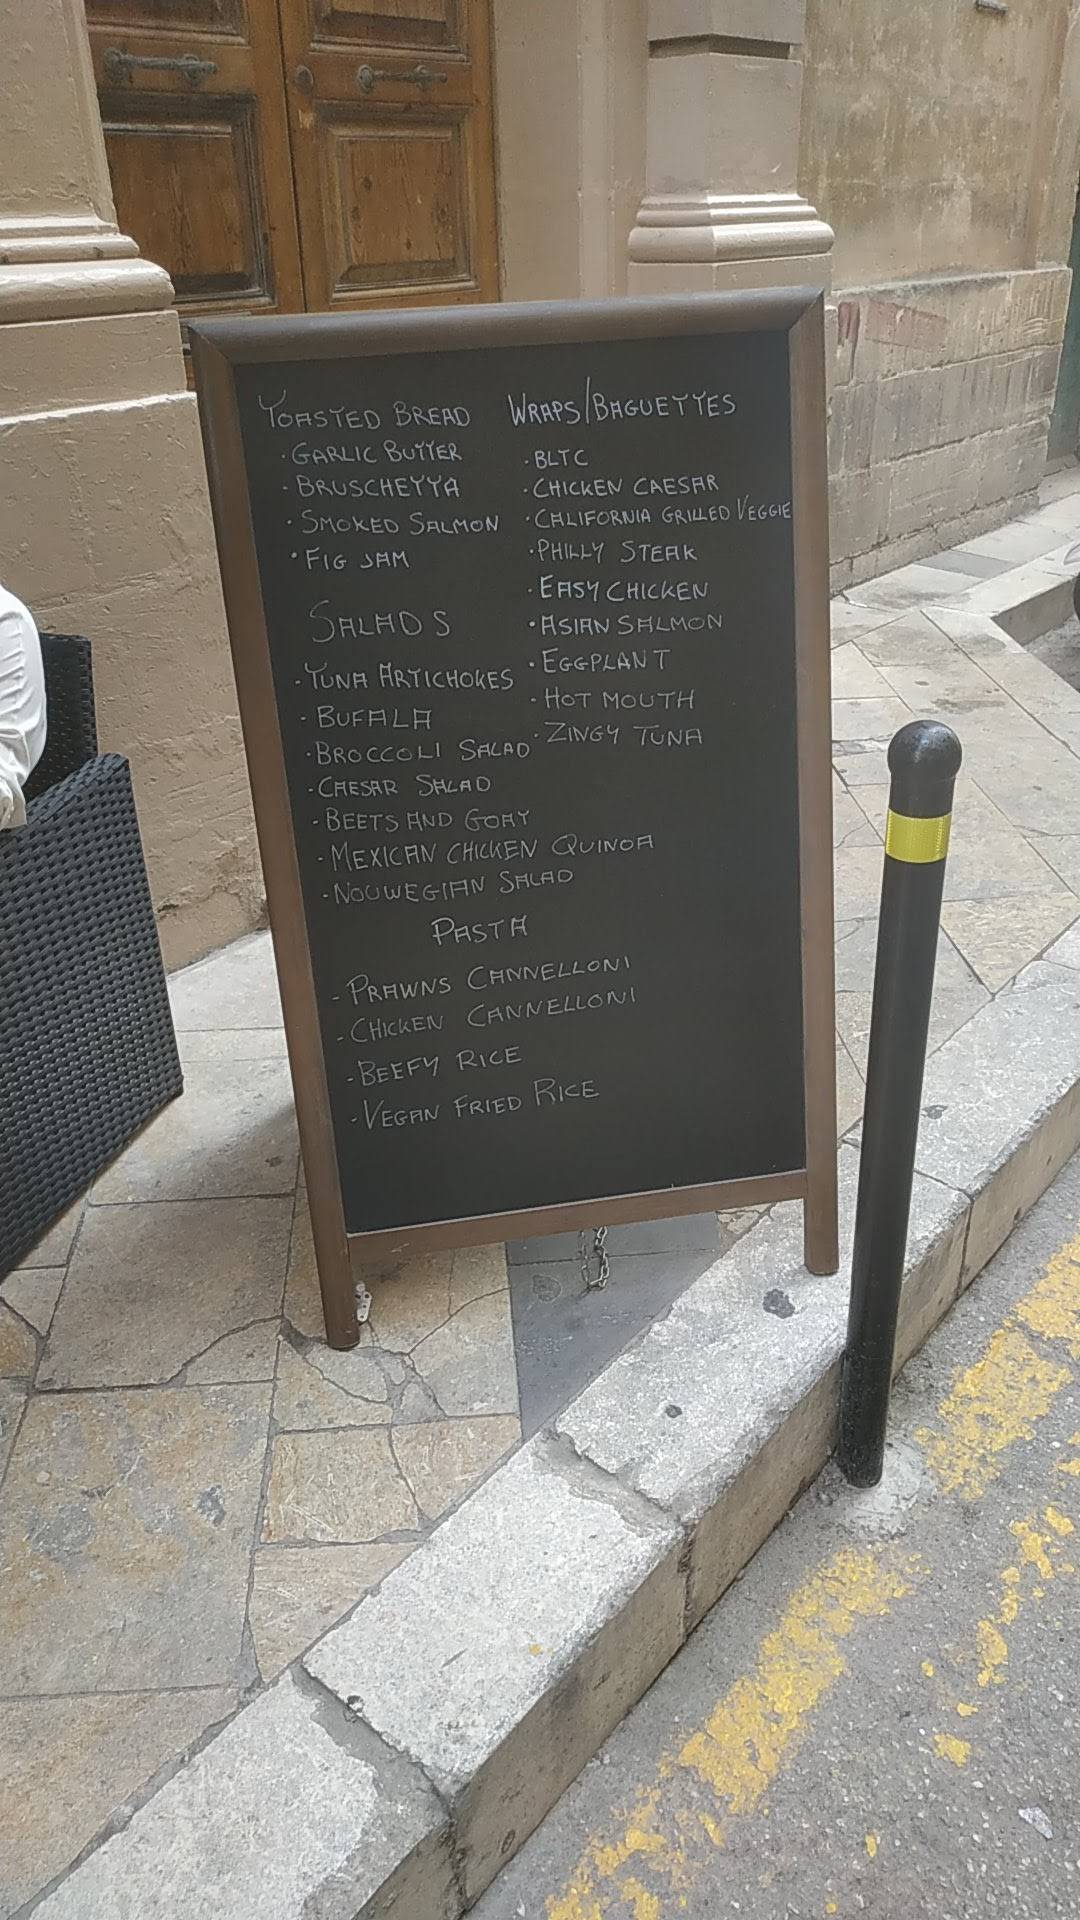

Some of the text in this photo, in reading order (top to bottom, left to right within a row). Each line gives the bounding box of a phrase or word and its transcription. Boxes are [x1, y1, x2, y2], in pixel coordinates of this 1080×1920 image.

[393, 400, 471, 427] BREAD
[291, 439, 463, 465] GARLIC BUTTER
[534, 449, 588, 469] BLTC
[296, 474, 460, 498] BRUSCHETTA
[532, 474, 719, 498] CHICKEN CAESAR
[301, 508, 500, 536] SMOKED SALMON
[534, 495, 792, 529] CALIFORNIA GRILLED VEGGIE
[306, 547, 411, 570] FIG JAM
[537, 539, 698, 563] PHILLY STEAK
[540, 575, 709, 602] EASY CHICKEN
[309, 600, 451, 643] SALADS
[541, 614, 723, 636] ASIAN SALMON
[542, 648, 671, 673] EGGPLANT
[304, 662, 514, 690] TUNA ARTICHOKES
[545, 687, 694, 709] HOT MOUTH
[317, 705, 432, 730] BUFALA
[545, 722, 703, 746] ZINGY TUNA
[315, 739, 530, 765] BROCCOLI SALAD
[317, 774, 491, 798] CAESAR SALAD
[326, 807, 399, 833] BEETS
[407, 811, 452, 831] AND
[331, 834, 654, 872] MEXICAN CHICKEN QUINOA
[500, 868, 574, 894] SALAD
[431, 915, 528, 945] PASTA
[346, 956, 631, 1005] PRAWNS CANNELLONI
[350, 987, 636, 1043] CHICKEN CANNELLONI
[357, 1046, 523, 1086] BEEFY RICE
[363, 1077, 600, 1129] VEGAN FRIED RICE
